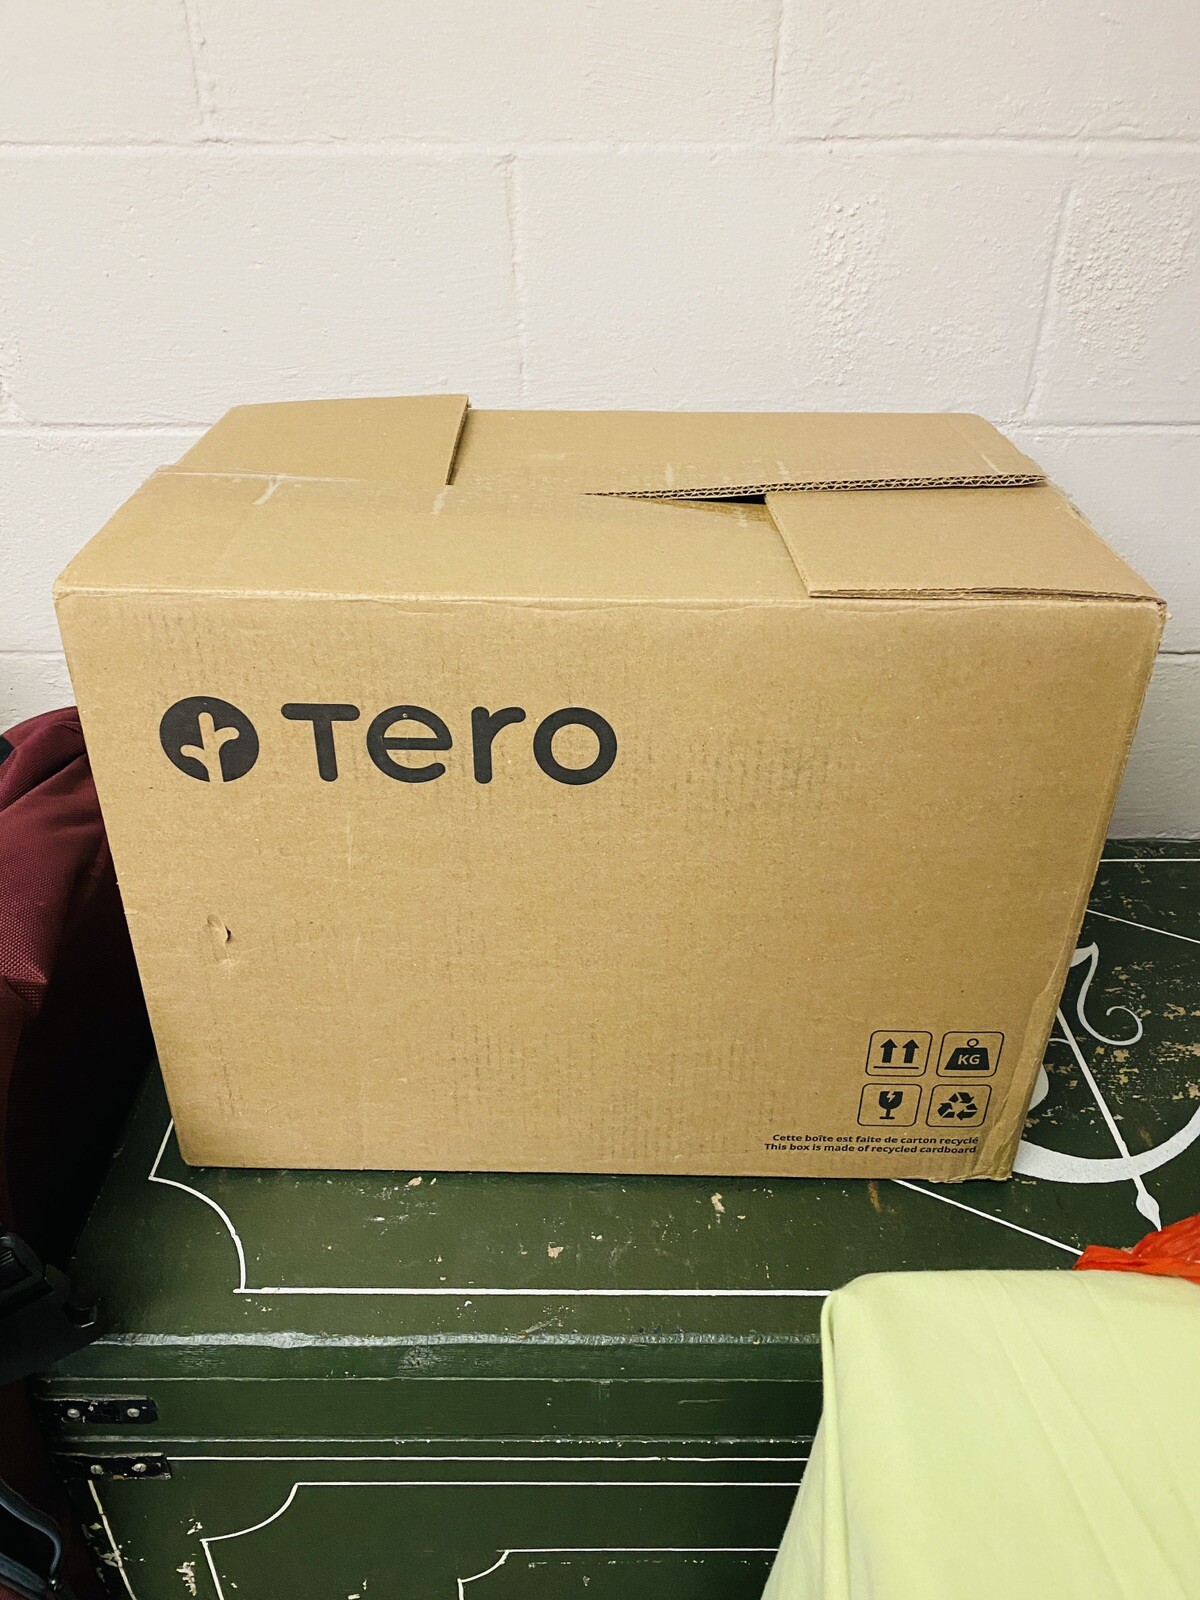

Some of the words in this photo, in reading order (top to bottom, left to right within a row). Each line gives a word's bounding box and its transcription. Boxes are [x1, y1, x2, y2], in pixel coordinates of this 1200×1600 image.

[281, 702, 618, 786] Tero
[956, 1054, 981, 1066] KG
[772, 1133, 803, 1142] Cette
[804, 1134, 834, 1143] boîte
[855, 1135, 882, 1143] faite
[883, 1136, 898, 1144] de
[939, 1136, 979, 1147] recyclé
[764, 1143, 787, 1151] This
[789, 1143, 810, 1151] box
[812, 1144, 822, 1152] is
[823, 1144, 855, 1152] made
[870, 1145, 918, 1155] recycled
[919, 1145, 977, 1154] cardboard
